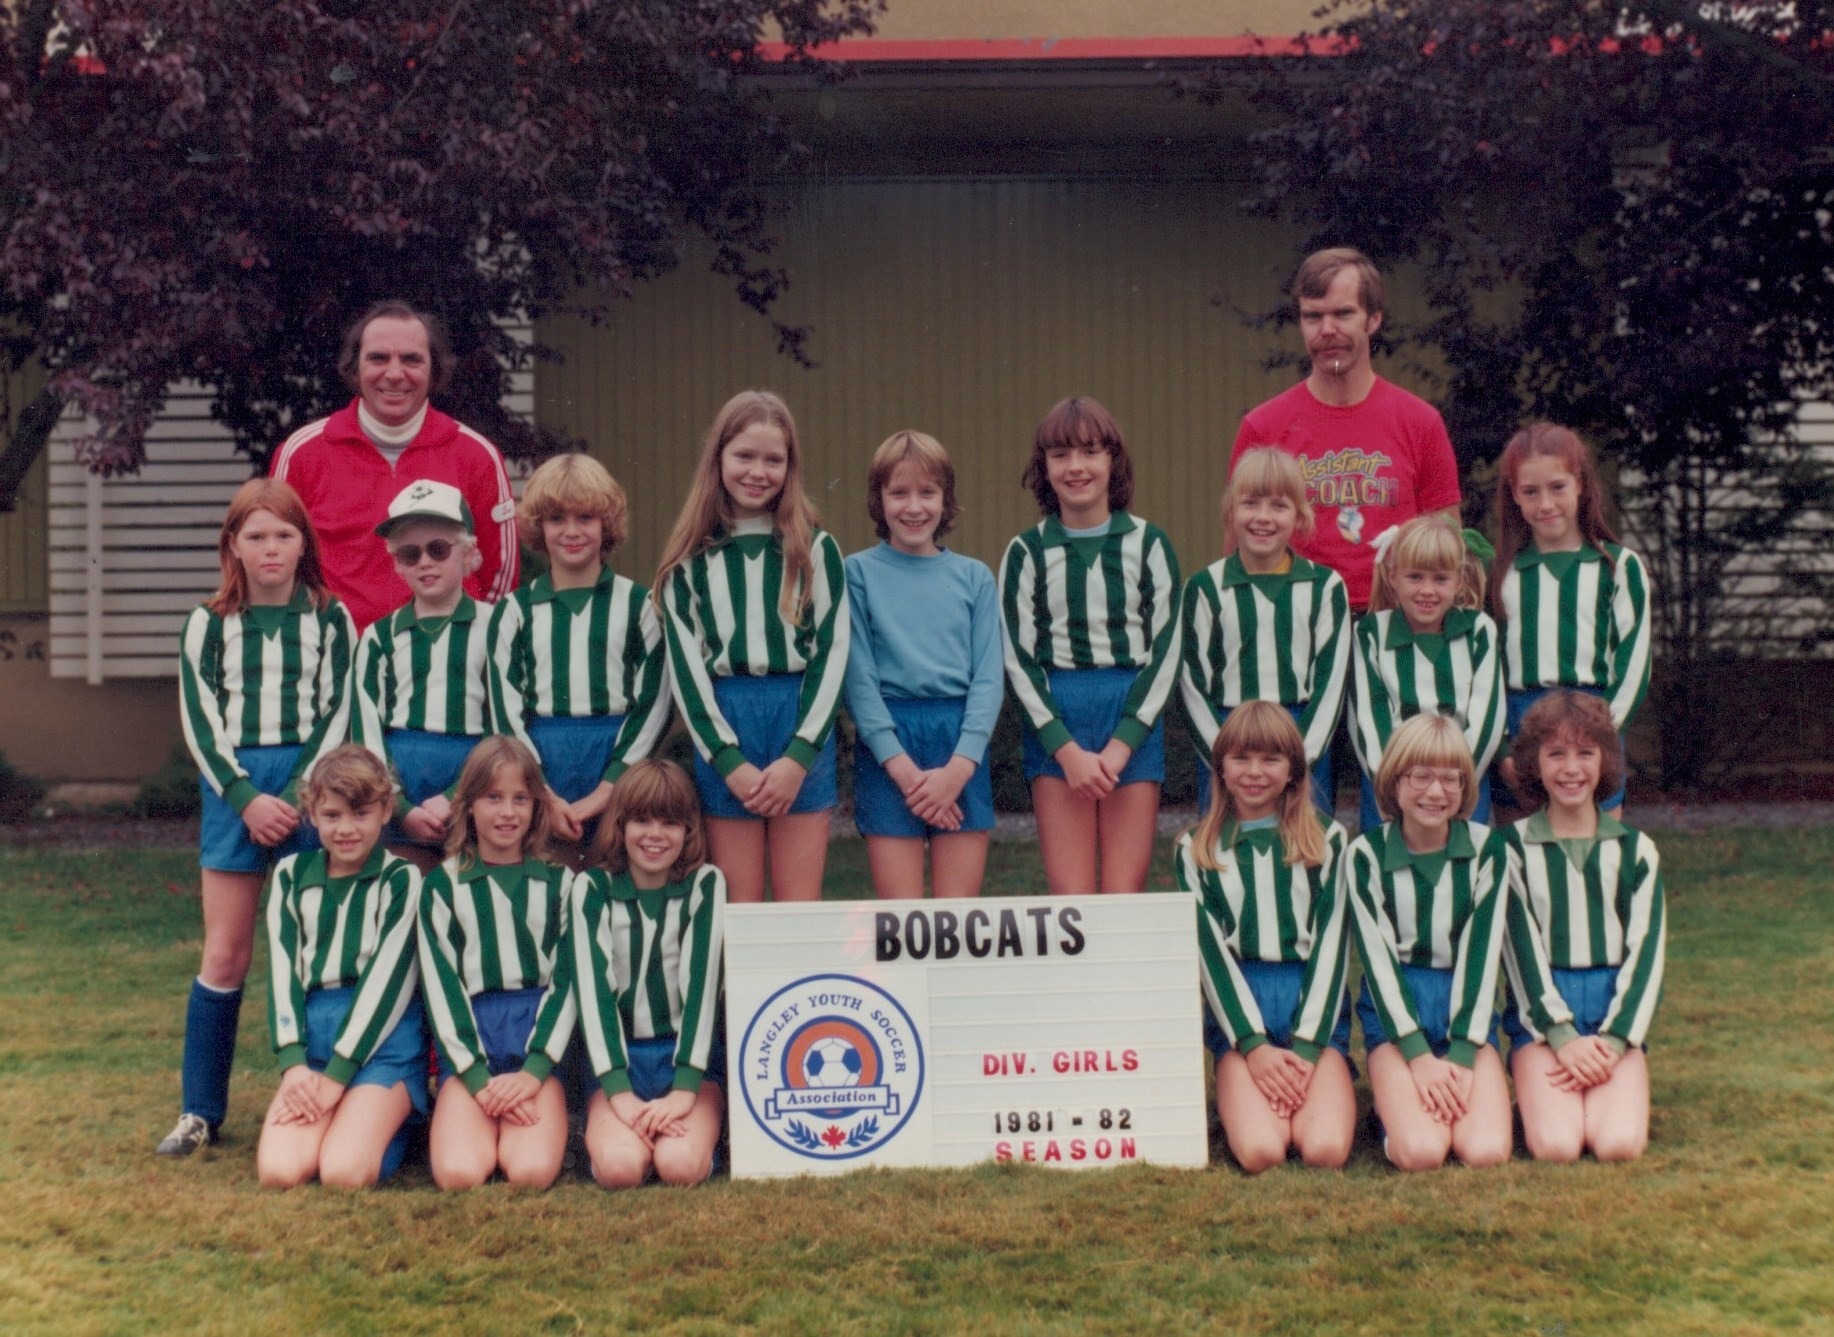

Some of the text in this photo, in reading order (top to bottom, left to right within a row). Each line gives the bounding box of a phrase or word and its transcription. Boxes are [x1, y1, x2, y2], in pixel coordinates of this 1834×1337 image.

[1303, 479, 1398, 506] COACH
[875, 907, 1086, 962] BOBCATS
[757, 993, 906, 1081] LANGLEY YOUTH SOCCER
[983, 1049, 1139, 1076] DIV. GIRLS
[786, 1090, 877, 1105] Association
[994, 1110, 1053, 1134] 1981
[1099, 1108, 1131, 1130] 82
[995, 1137, 1136, 1164] SEASON
